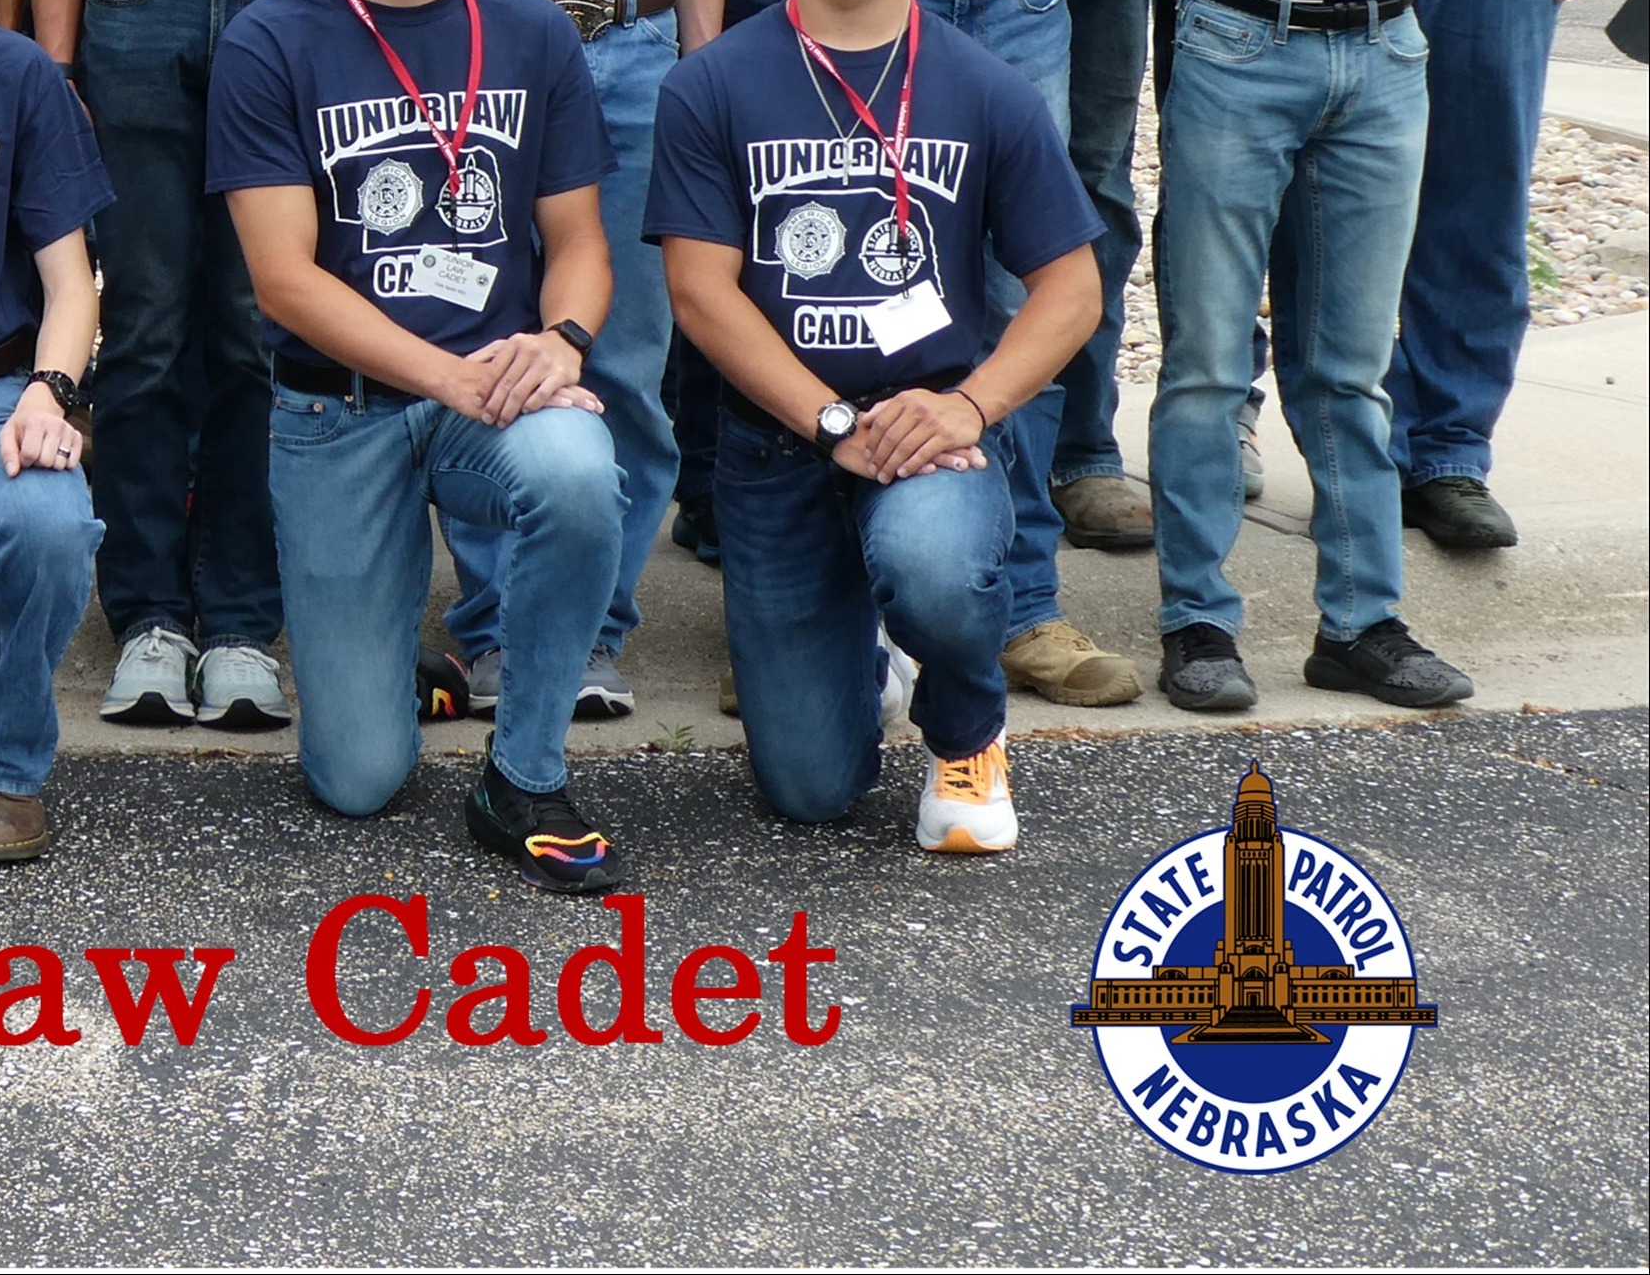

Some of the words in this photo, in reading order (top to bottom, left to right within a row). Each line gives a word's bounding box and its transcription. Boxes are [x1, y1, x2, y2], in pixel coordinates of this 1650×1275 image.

[317, 91, 447, 170] JUNIOR
[747, 137, 877, 204] JUNIOR
[790, 257, 828, 271] LEGION
[794, 305, 879, 349] CADE
